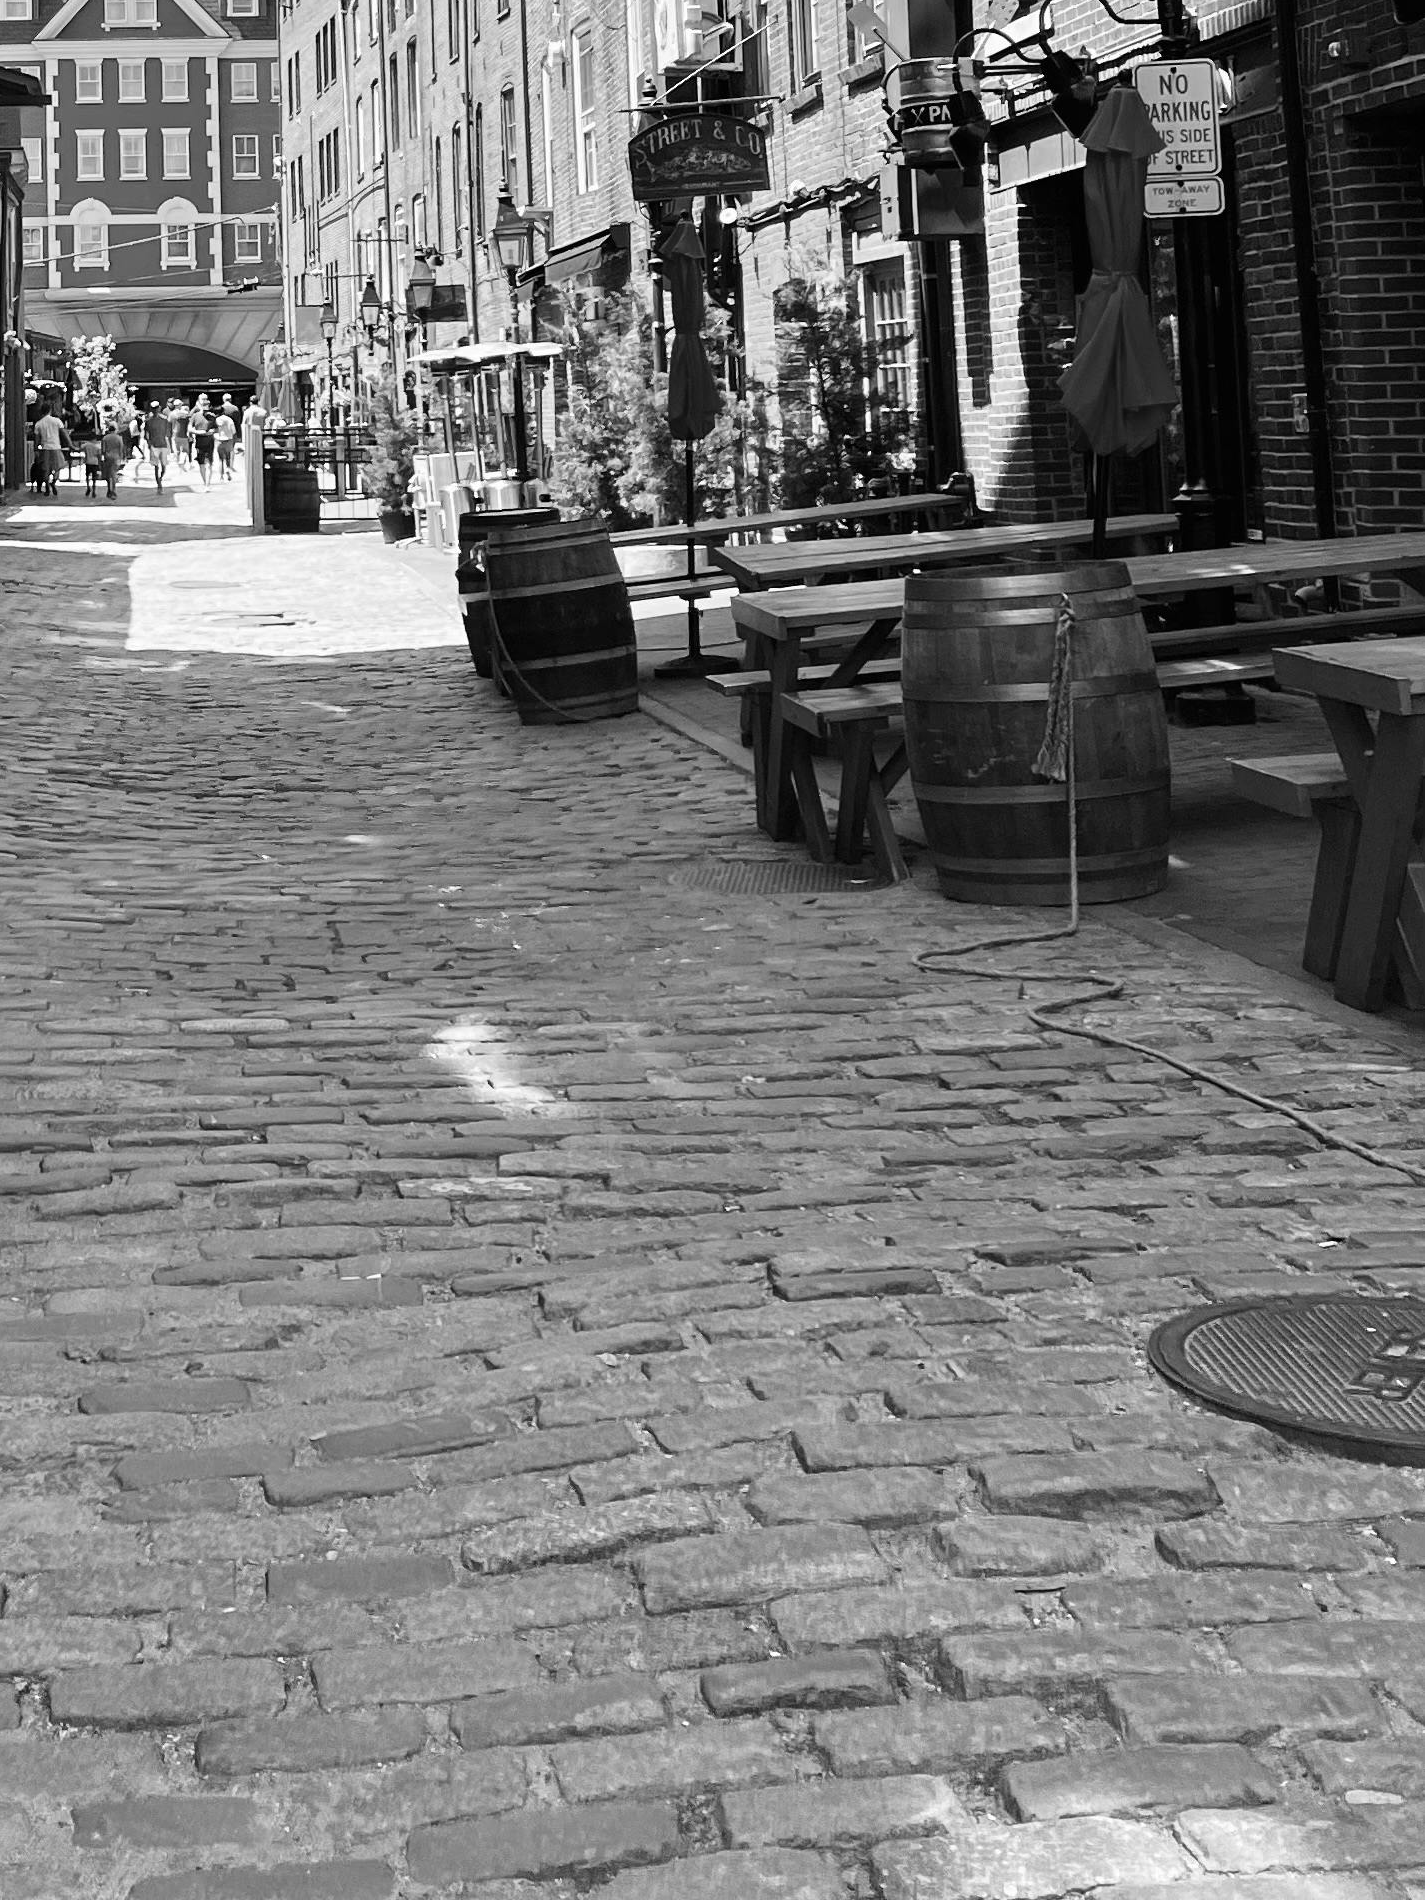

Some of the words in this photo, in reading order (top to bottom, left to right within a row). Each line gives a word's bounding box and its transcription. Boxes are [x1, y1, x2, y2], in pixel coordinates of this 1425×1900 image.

[1158, 74, 1188, 95] NO
[1180, 128, 1212, 143] SIDE
[635, 119, 703, 169] STREET
[713, 120, 725, 140] &
[1165, 149, 1214, 165] STREET
[1152, 185, 1210, 196] TOW-AWAY
[1167, 199, 1197, 208] ZONE
